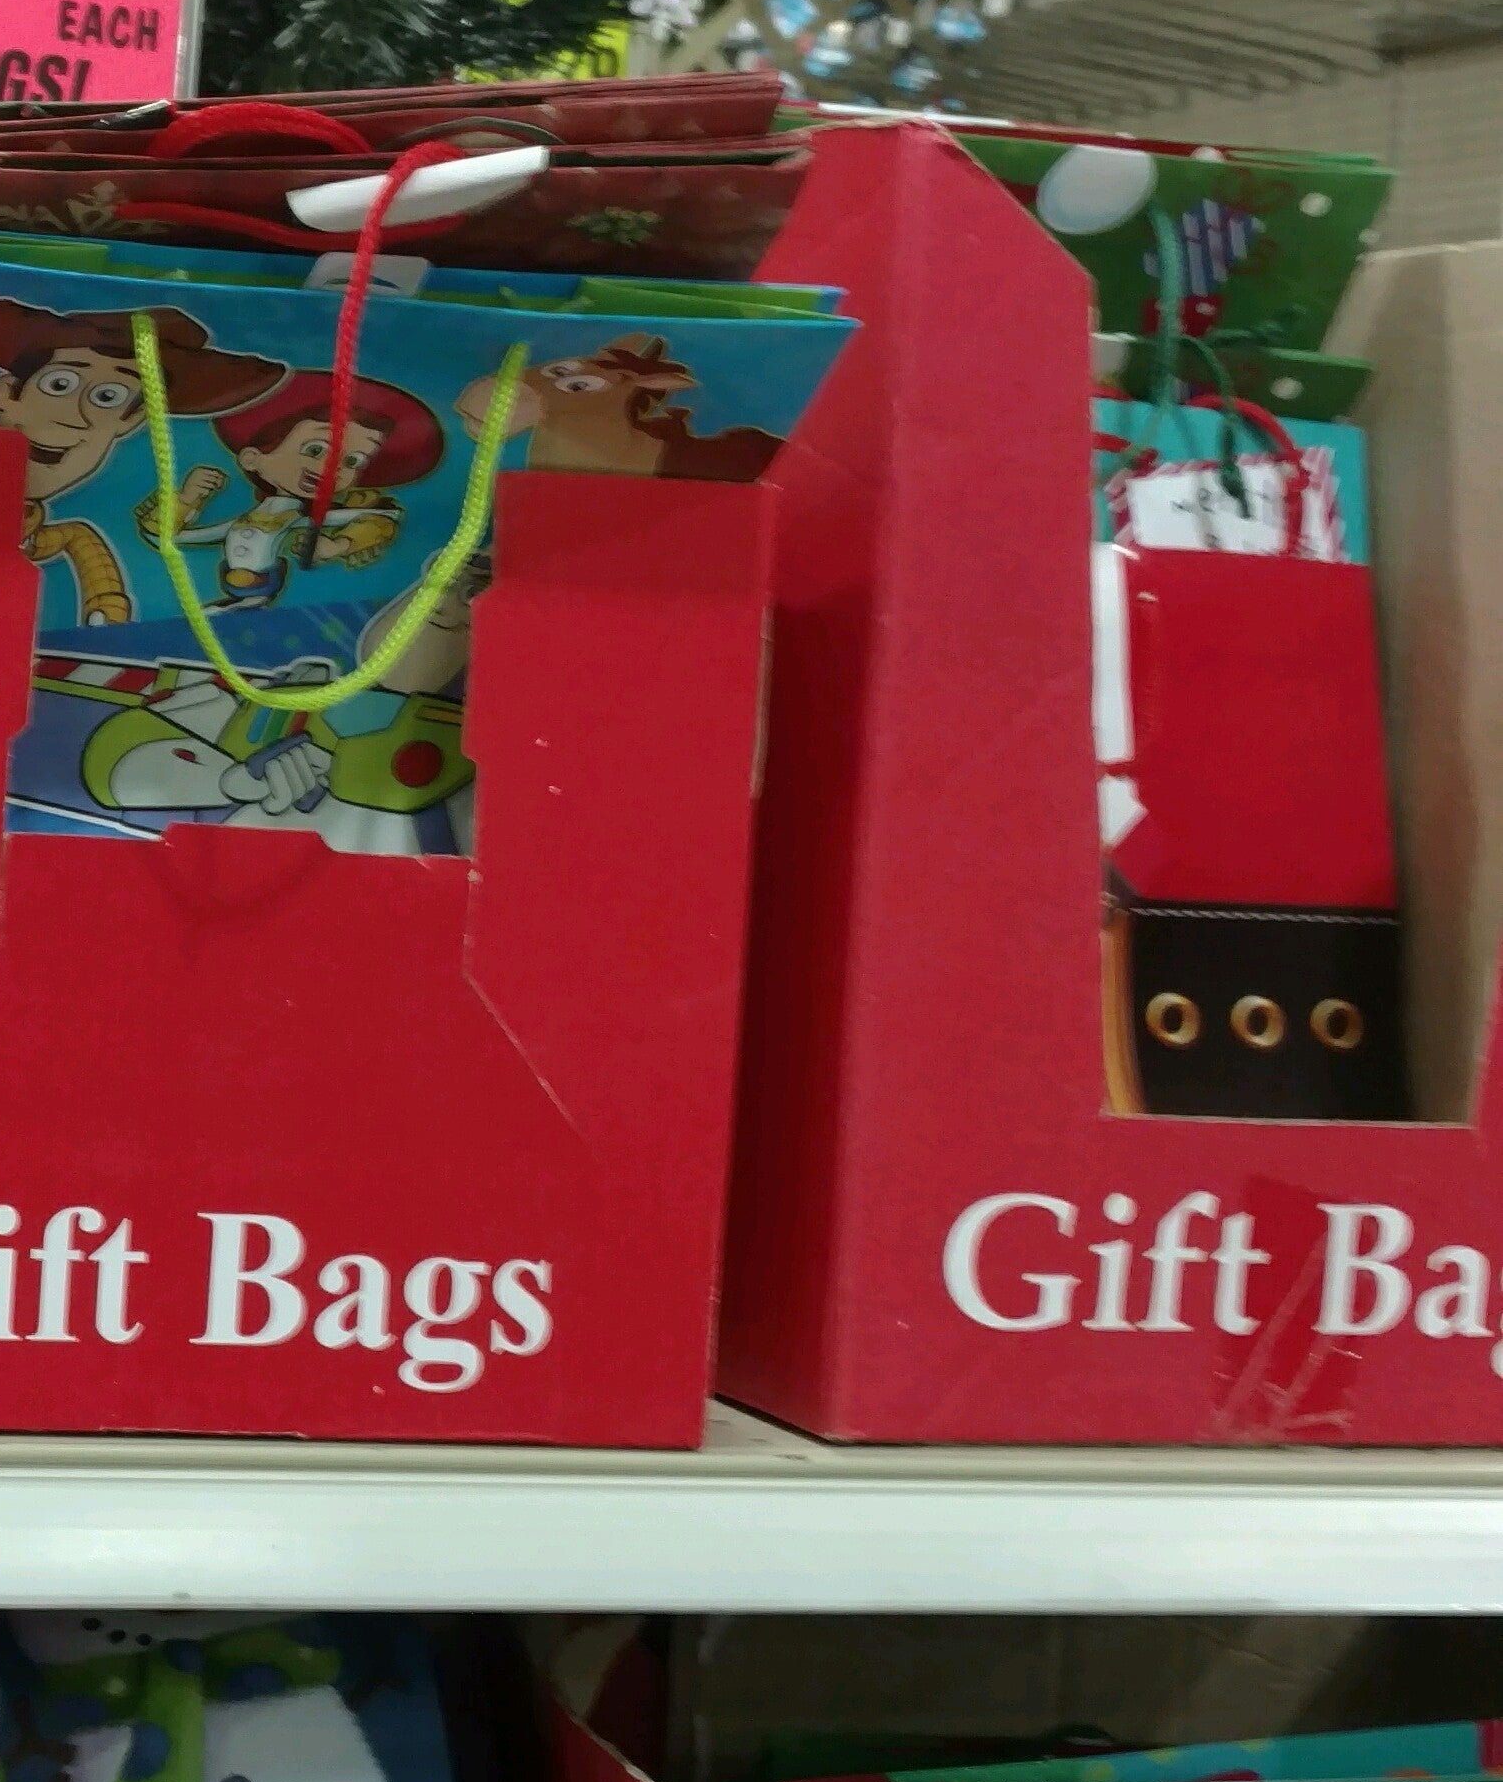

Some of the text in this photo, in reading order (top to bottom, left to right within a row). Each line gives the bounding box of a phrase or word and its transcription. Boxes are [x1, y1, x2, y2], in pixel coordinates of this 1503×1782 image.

[57, 0, 161, 51] EACH
[188, 1212, 554, 1393] Bags
[943, 1190, 1503, 1377] Gift Ba
